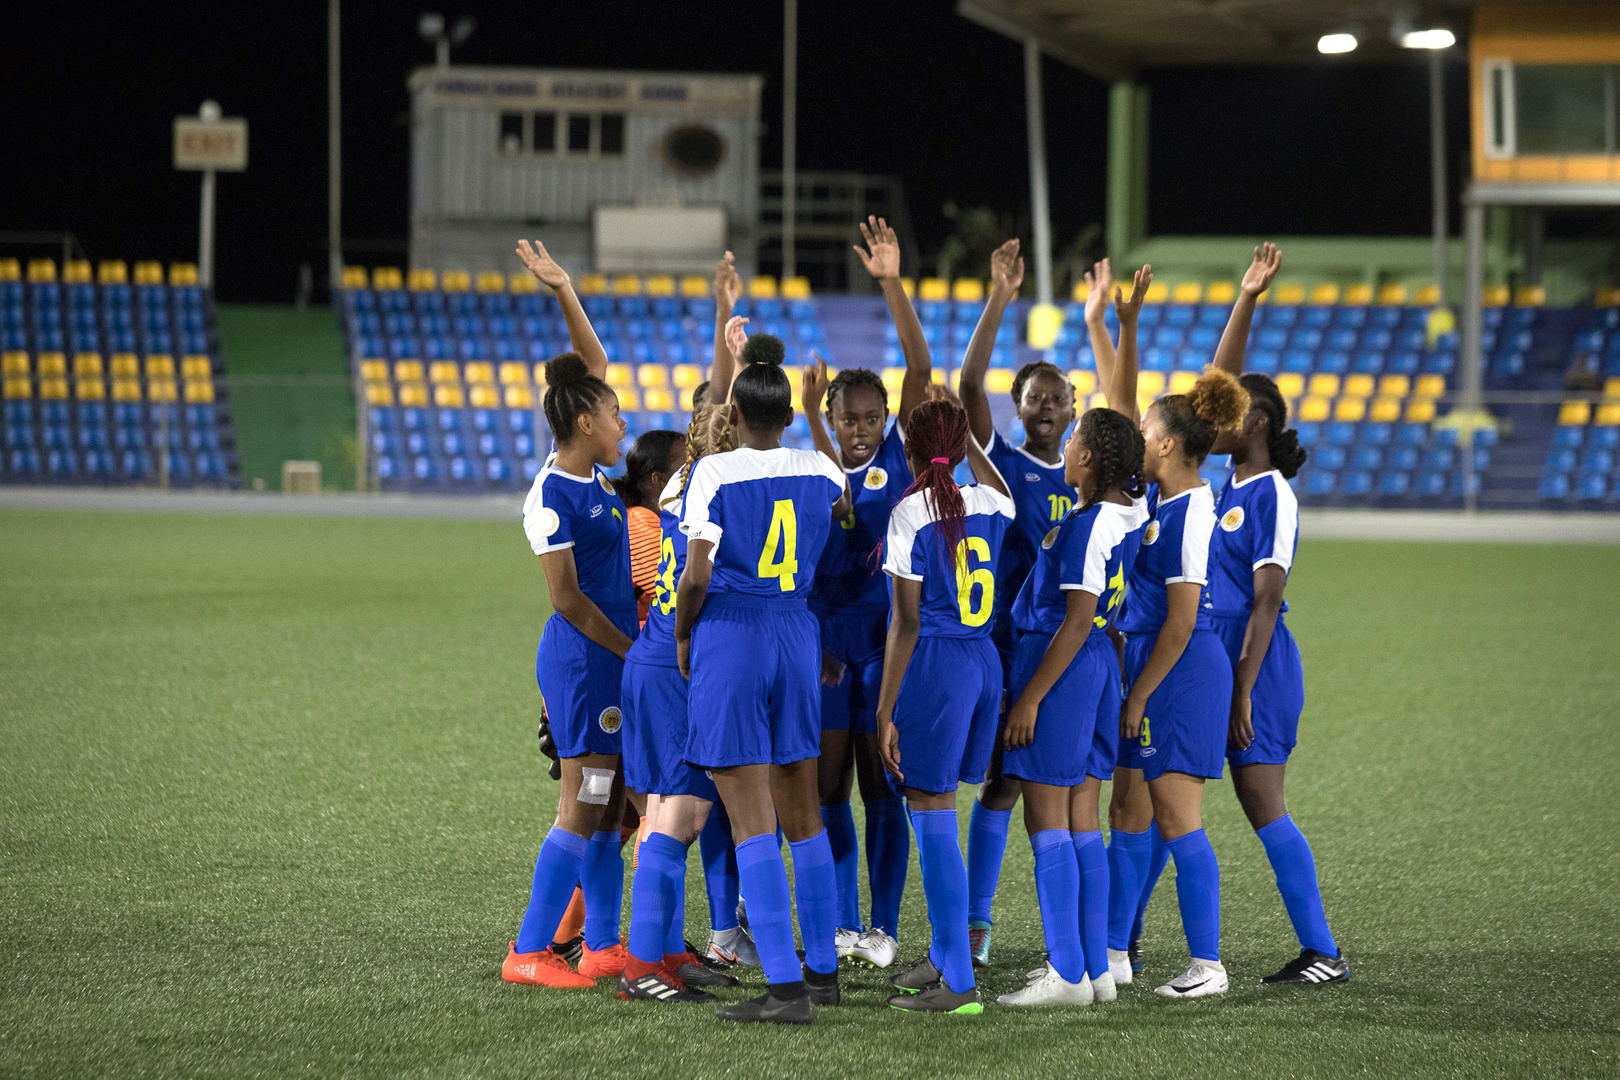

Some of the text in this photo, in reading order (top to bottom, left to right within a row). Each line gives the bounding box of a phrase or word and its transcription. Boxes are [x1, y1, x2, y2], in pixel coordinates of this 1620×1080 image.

[1048, 494, 1072, 521] 10
[758, 499, 798, 592] 4
[955, 536, 995, 627] 6
[1140, 717, 1152, 747] 9
